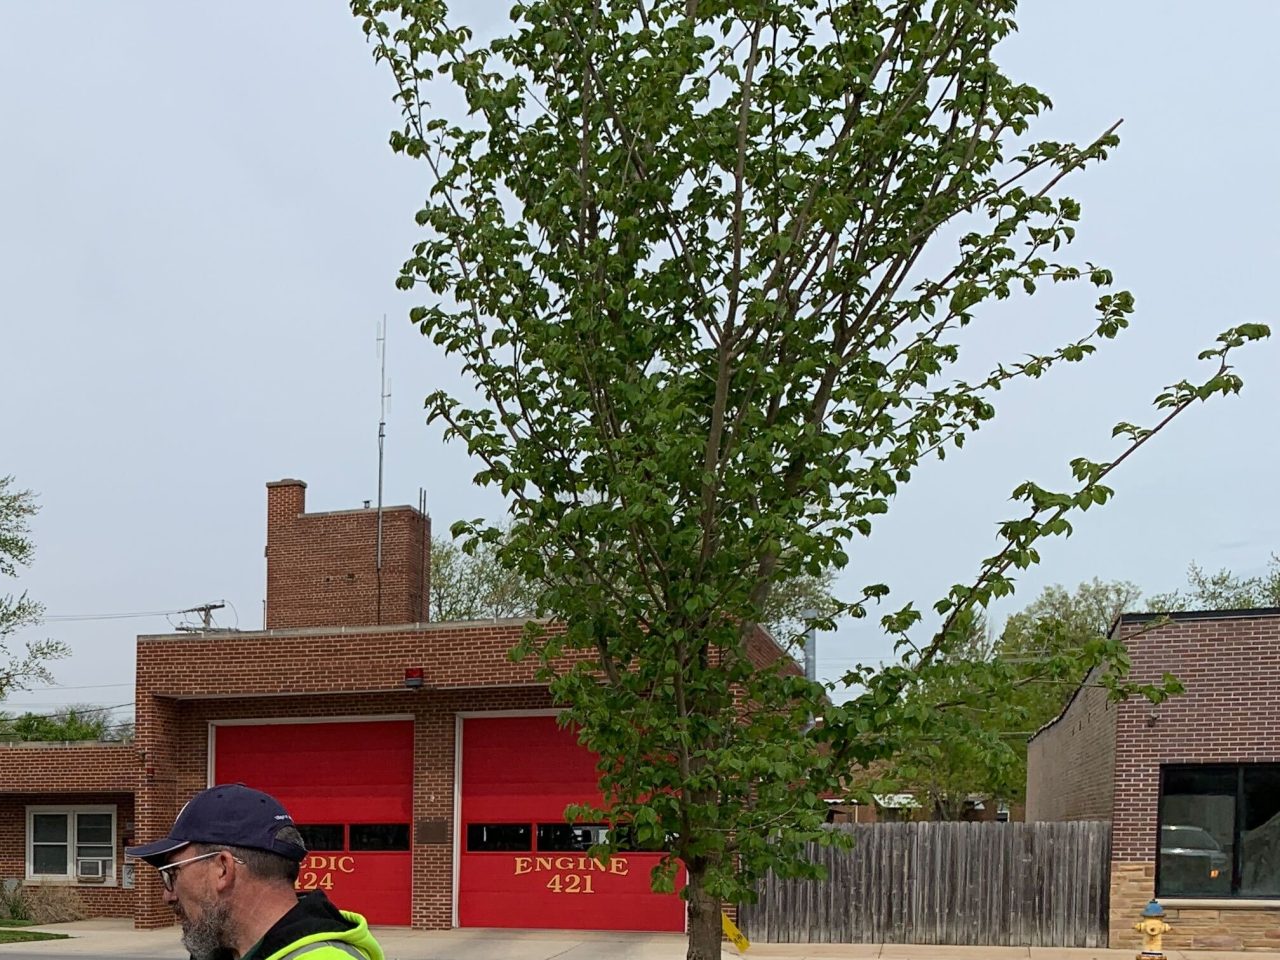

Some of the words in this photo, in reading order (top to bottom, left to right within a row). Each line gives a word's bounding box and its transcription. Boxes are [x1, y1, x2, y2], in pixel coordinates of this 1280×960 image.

[299, 856, 355, 873] DIC
[514, 857, 629, 876] ENGINE
[546, 874, 595, 893] 421
